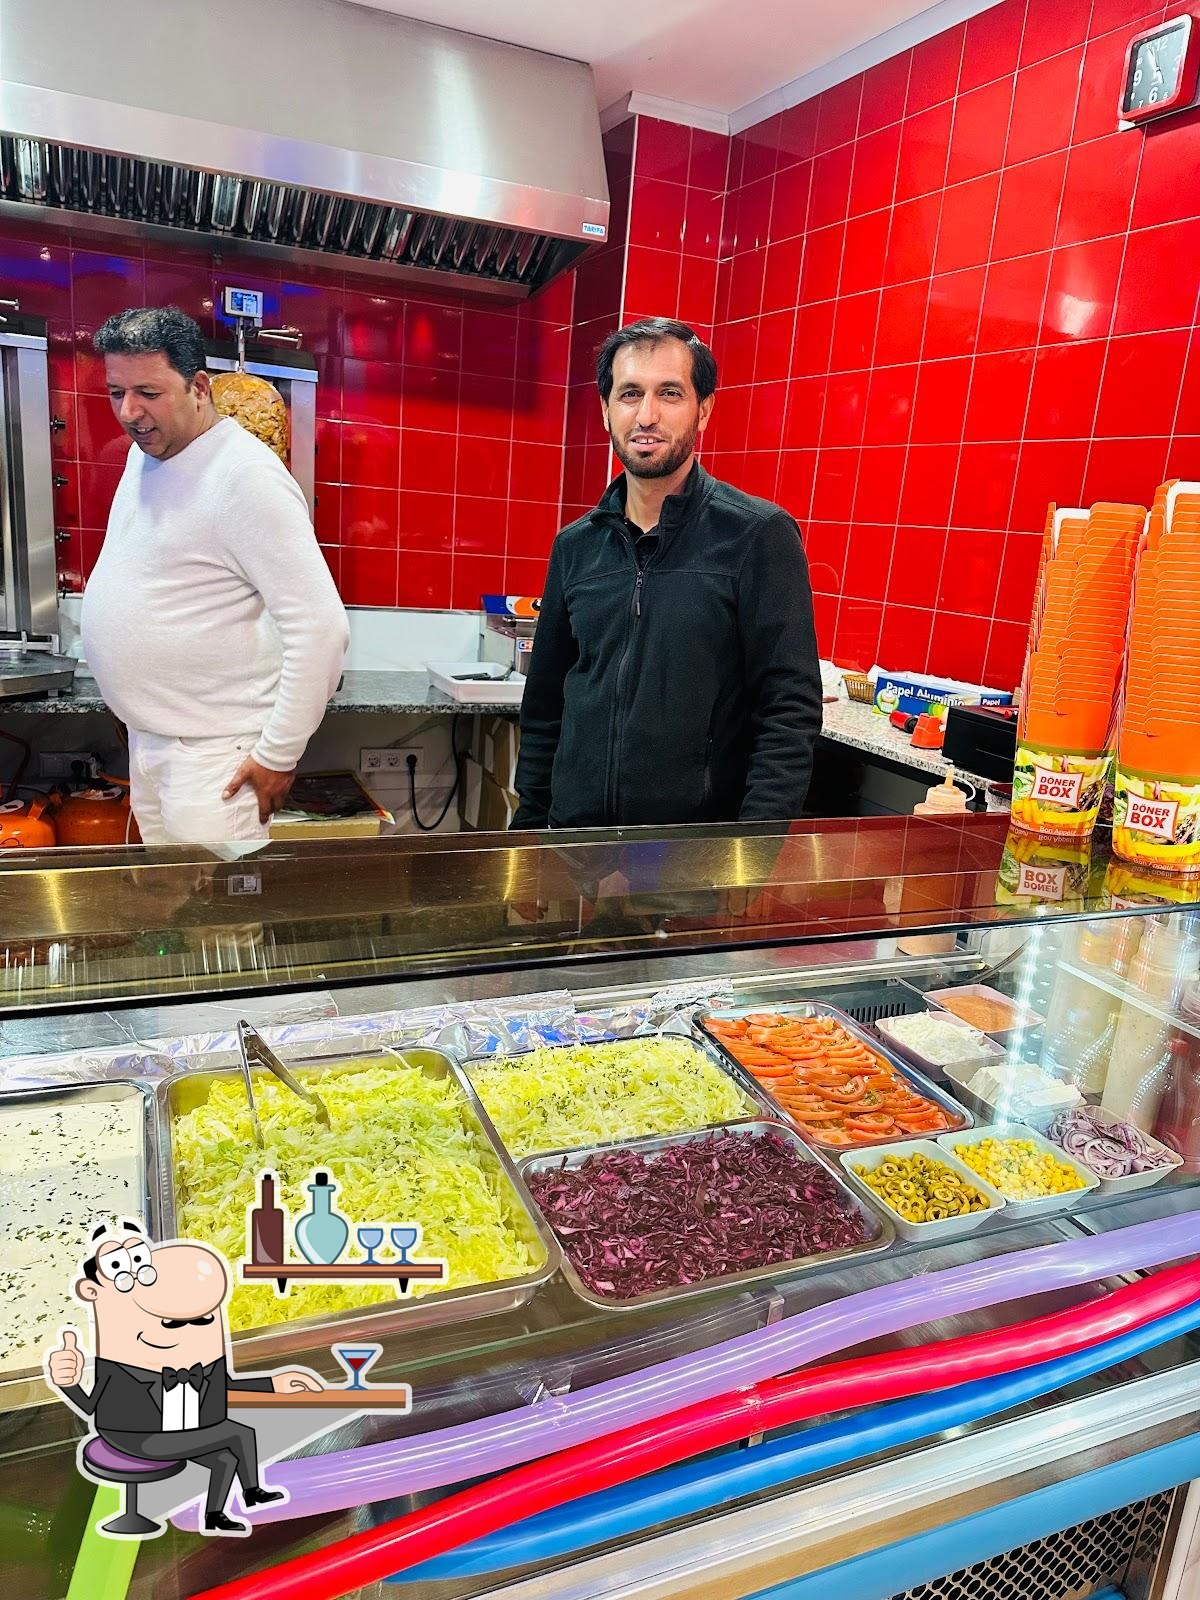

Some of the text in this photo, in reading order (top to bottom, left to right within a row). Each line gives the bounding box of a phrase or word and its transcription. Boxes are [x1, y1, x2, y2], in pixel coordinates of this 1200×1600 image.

[1133, 69, 1142, 86] 9
[1149, 87, 1158, 103] 6
[886, 682, 964, 706] Papel Aluminio
[982, 698, 1001, 706] Papel
[1038, 784, 1073, 798] BOX
[1132, 803, 1170, 817] DÖNER
[1130, 812, 1167, 829] BOX
